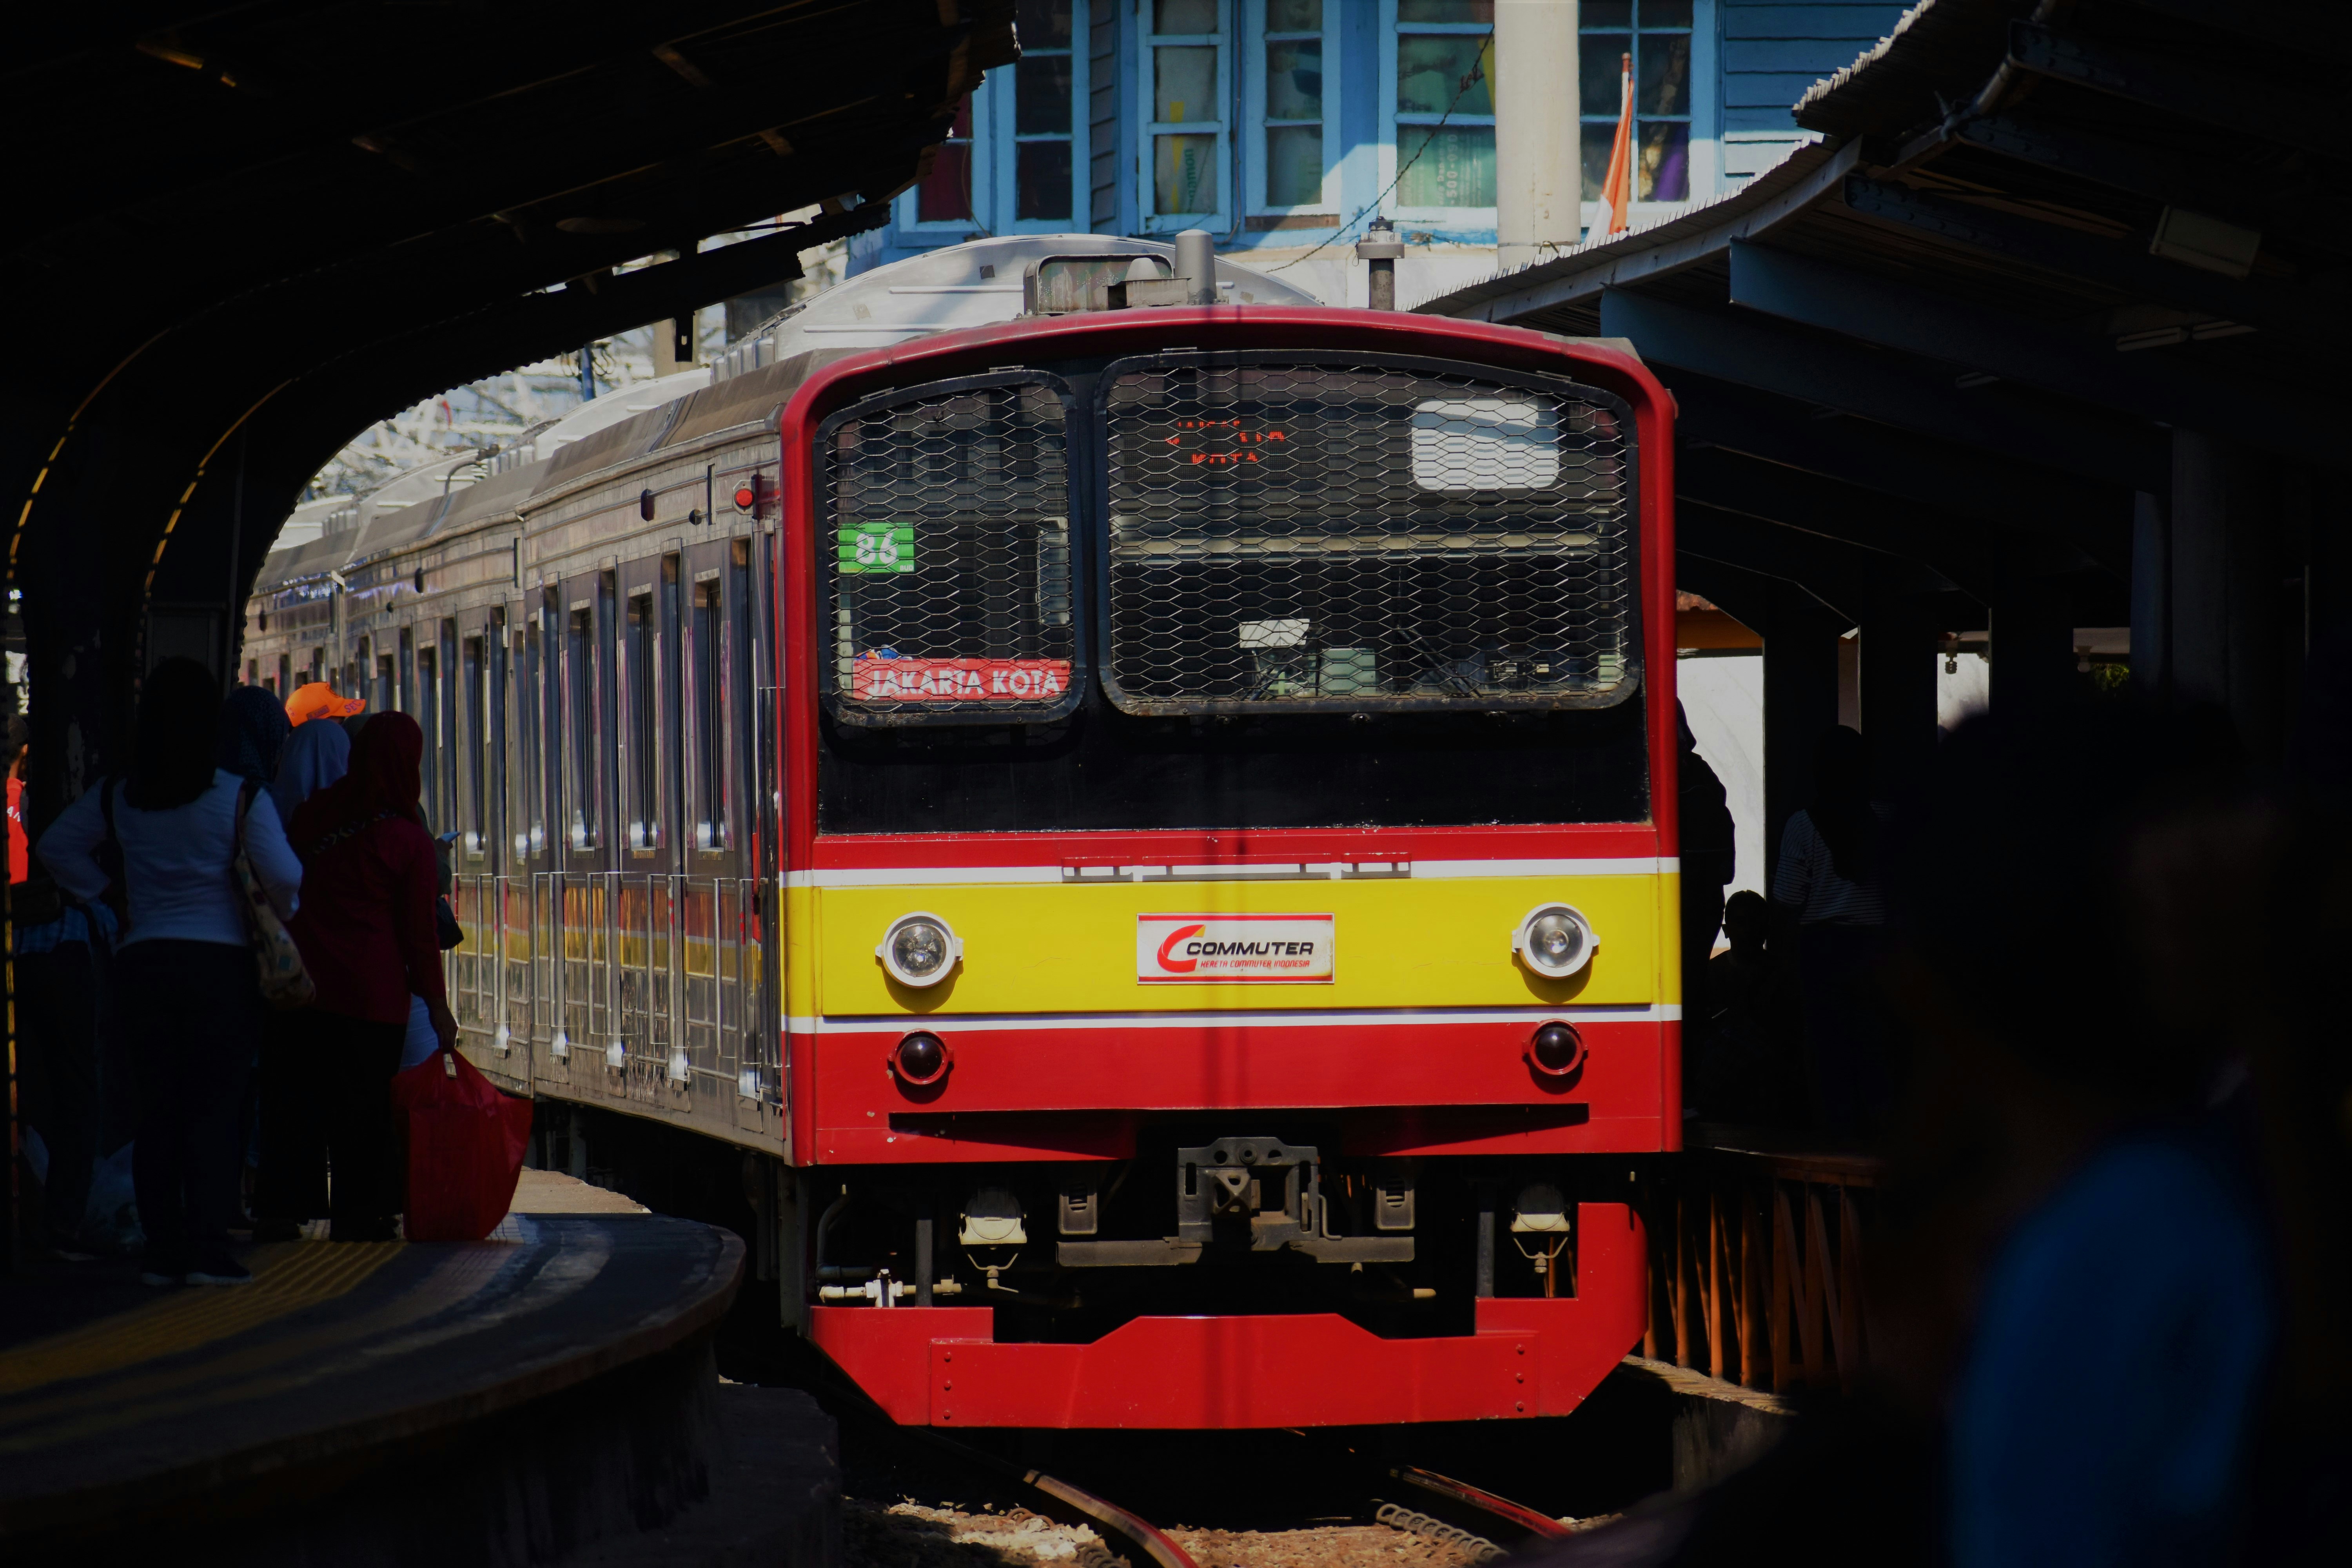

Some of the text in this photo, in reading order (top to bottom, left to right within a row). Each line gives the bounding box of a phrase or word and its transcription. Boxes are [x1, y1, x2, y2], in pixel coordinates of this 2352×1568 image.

[856, 532, 897, 564] 86
[867, 670, 1060, 695] JAKARTA KOTA
[1186, 942, 1314, 955] COMMUTER
[1200, 960, 1227, 968] KERETA
[1274, 960, 1310, 968] INDONESIA
